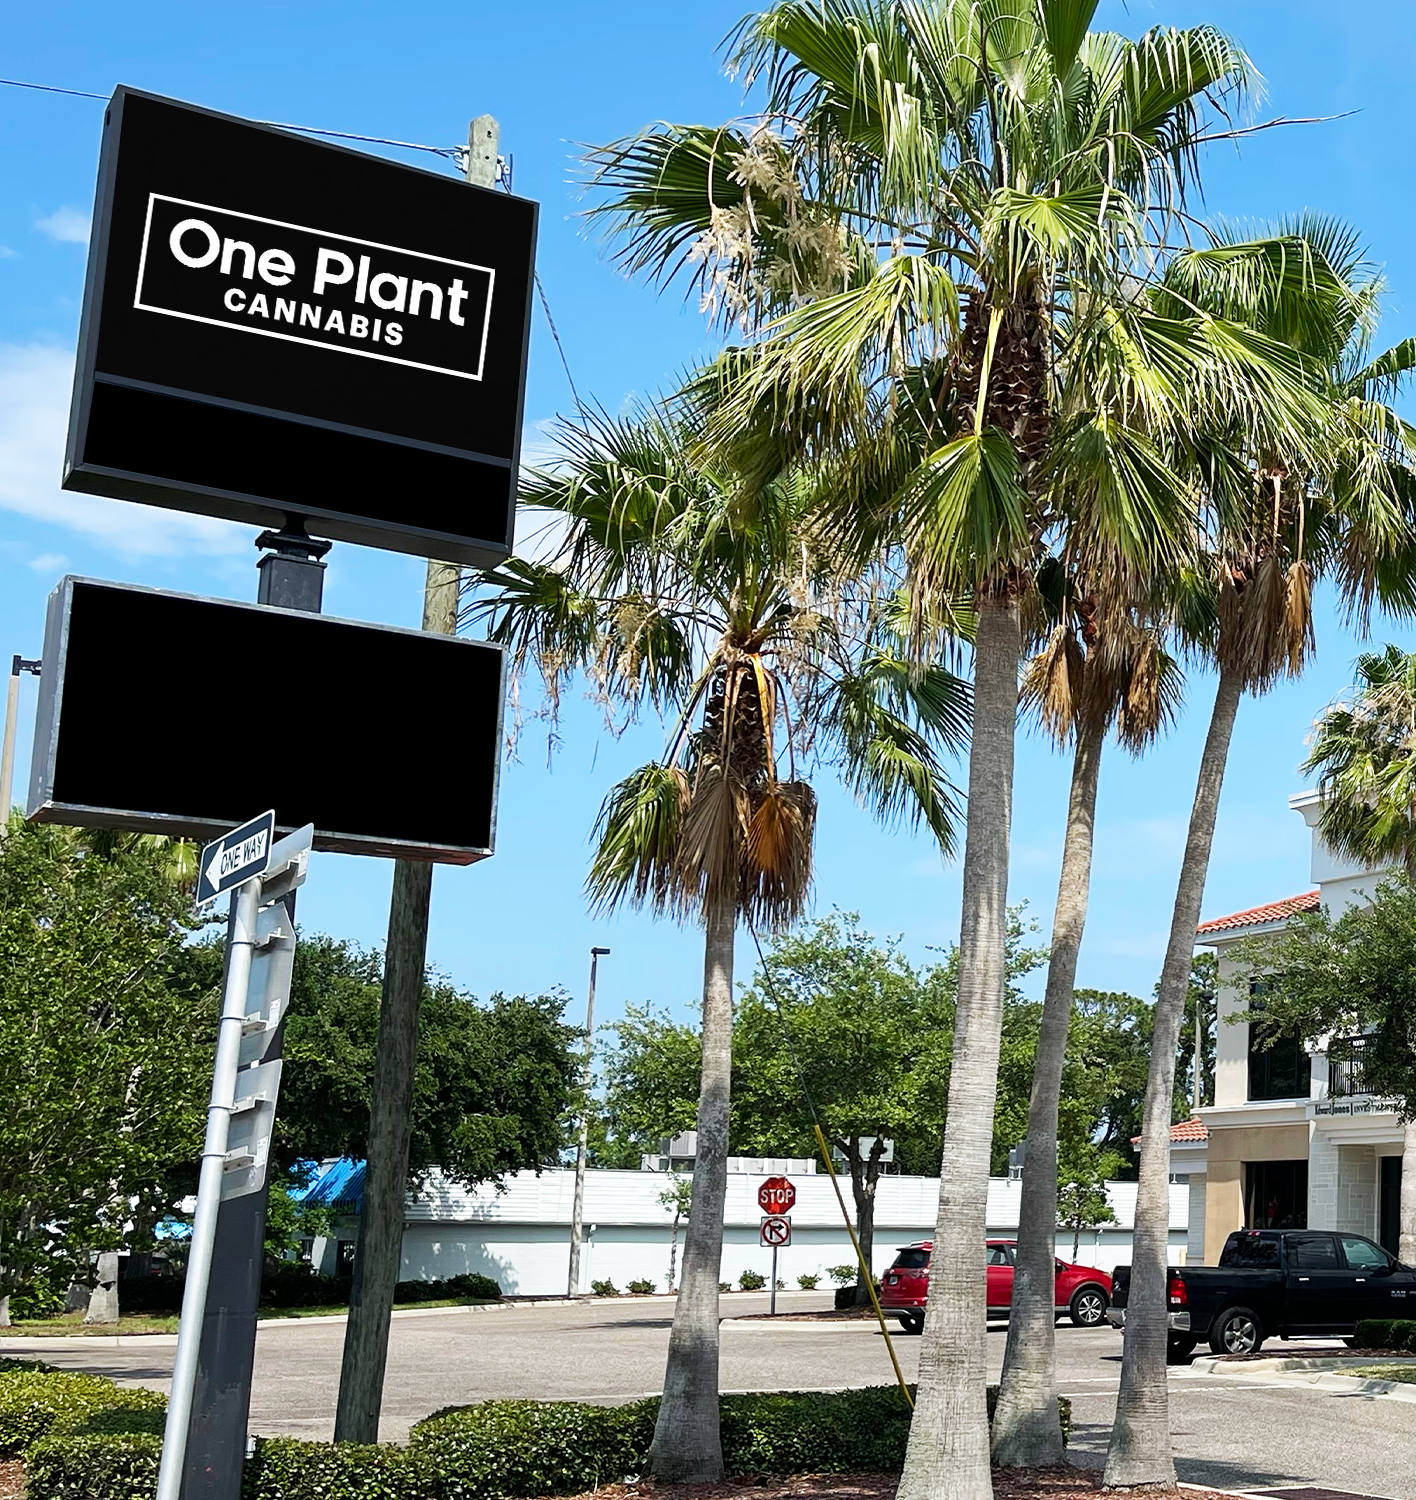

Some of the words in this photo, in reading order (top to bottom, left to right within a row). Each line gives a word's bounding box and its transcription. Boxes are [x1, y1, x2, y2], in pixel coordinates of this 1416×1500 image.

[169, 218, 296, 286] One
[313, 247, 469, 327] Plant
[223, 287, 404, 346] CANNABIS
[220, 846, 241, 875] ONE
[243, 832, 266, 863] WAY
[761, 1189, 793, 1204] STOP
